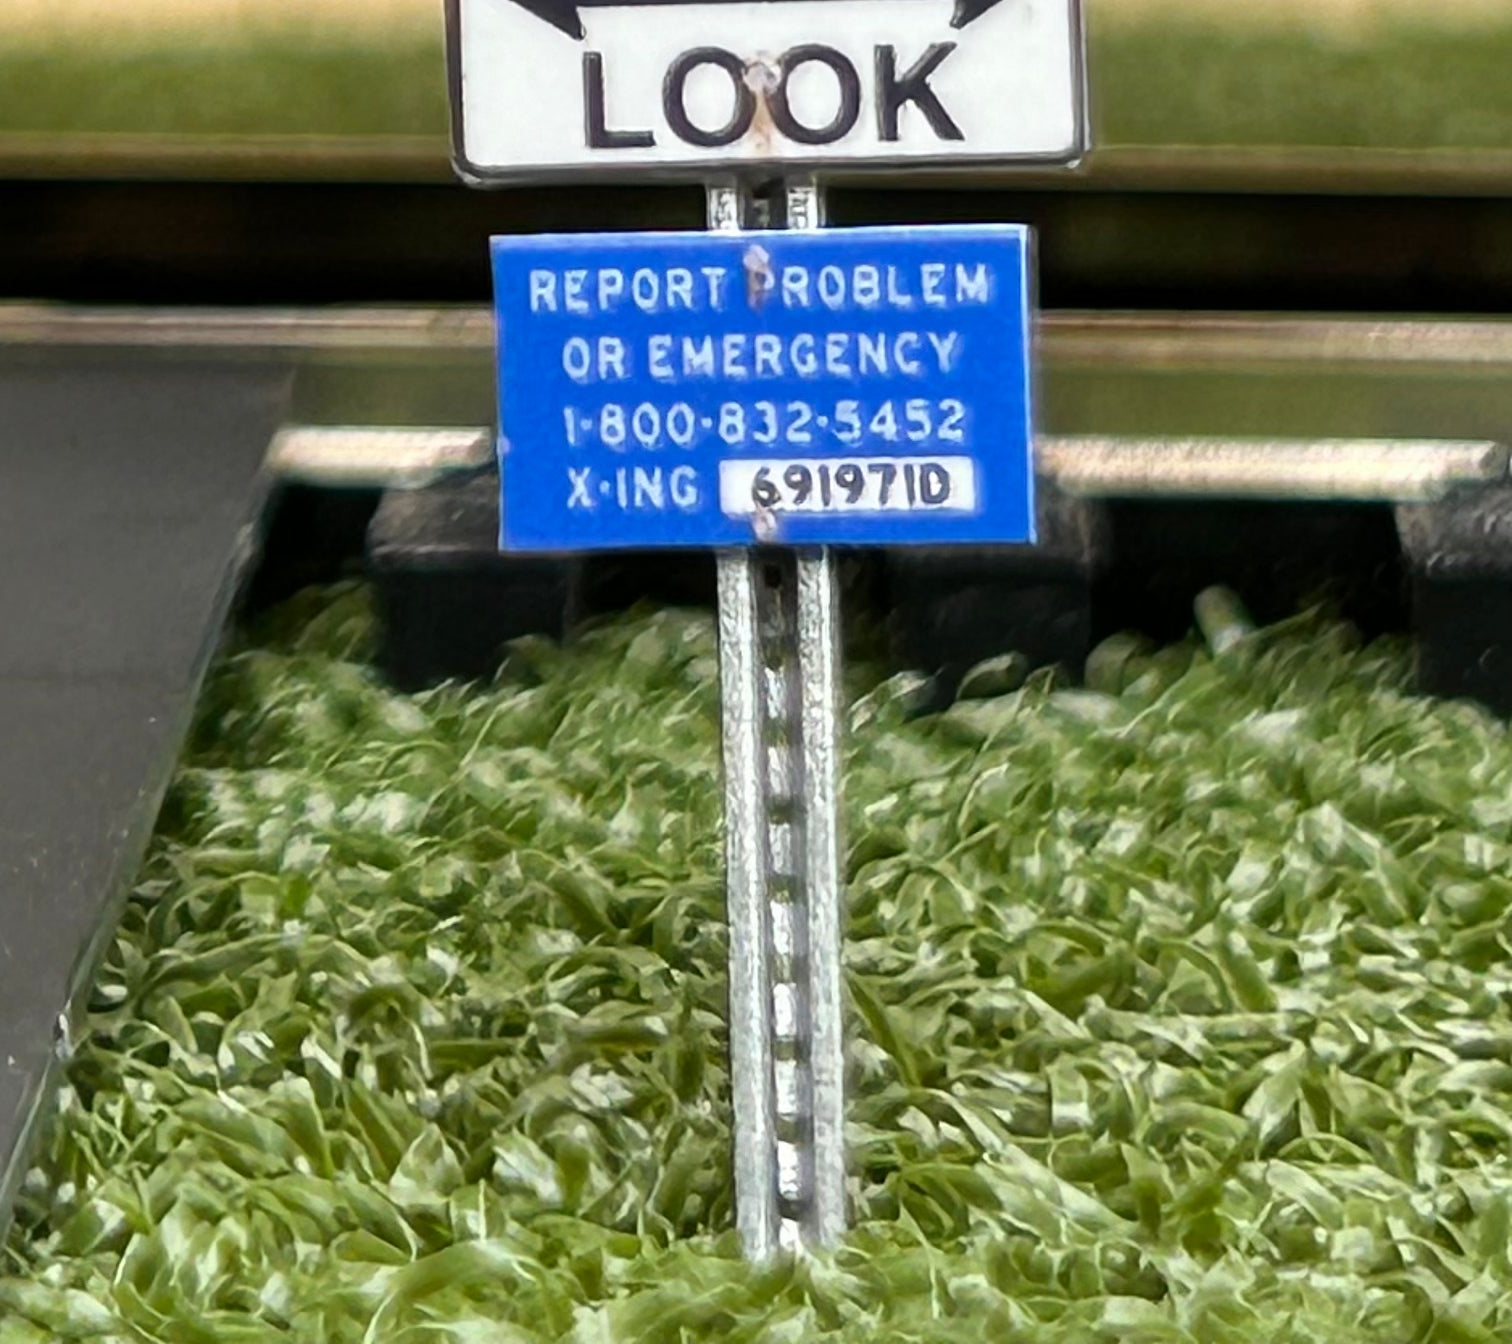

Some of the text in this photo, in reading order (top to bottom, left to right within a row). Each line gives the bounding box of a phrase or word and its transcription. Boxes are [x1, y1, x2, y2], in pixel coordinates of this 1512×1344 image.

[580, 40, 965, 150] LOOK
[529, 266, 727, 313] REPORT
[562, 331, 959, 381] OR EMERGENCY
